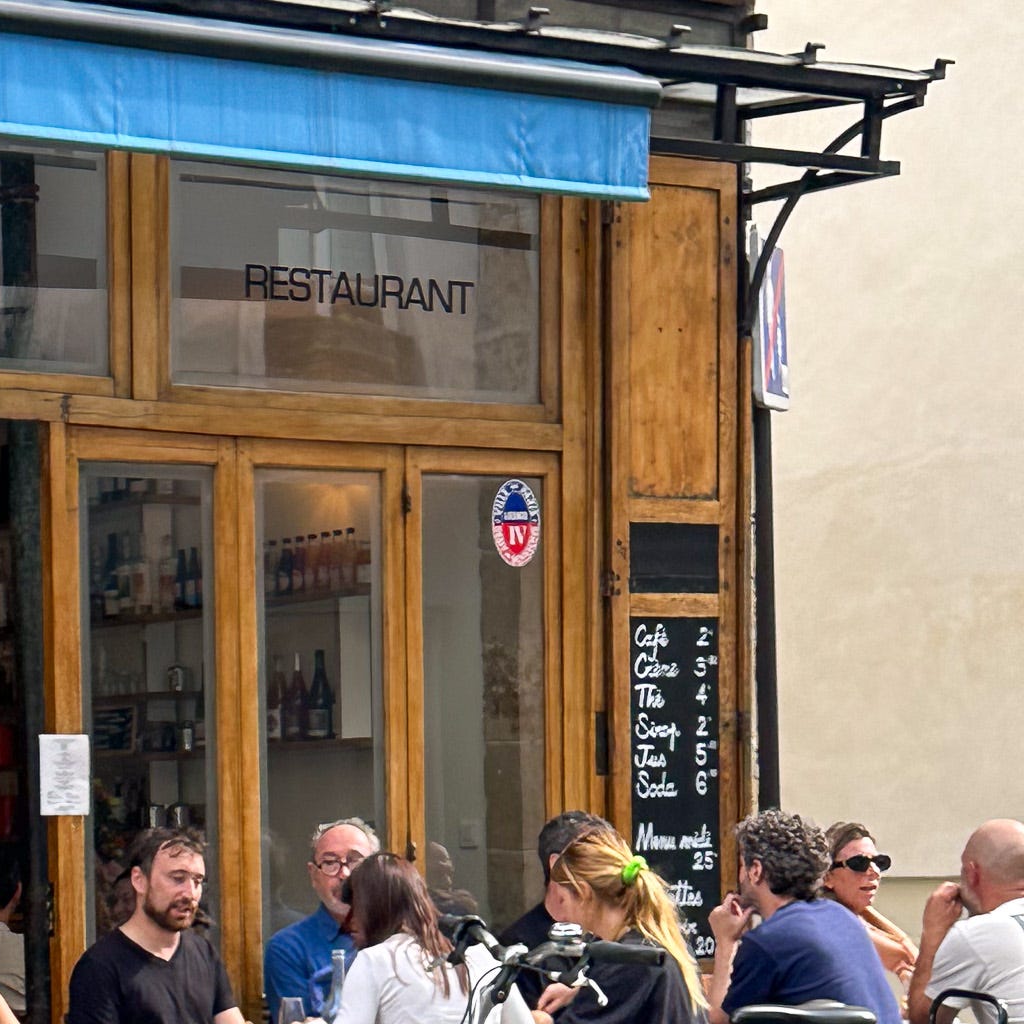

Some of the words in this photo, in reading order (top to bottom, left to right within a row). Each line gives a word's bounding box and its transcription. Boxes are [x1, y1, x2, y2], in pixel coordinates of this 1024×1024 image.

[245, 264, 474, 314] RESTAURANT
[508, 525, 527, 546] IV
[634, 744, 667, 768] Jus
[636, 770, 678, 799] Soda
[636, 822, 676, 851] Menu
